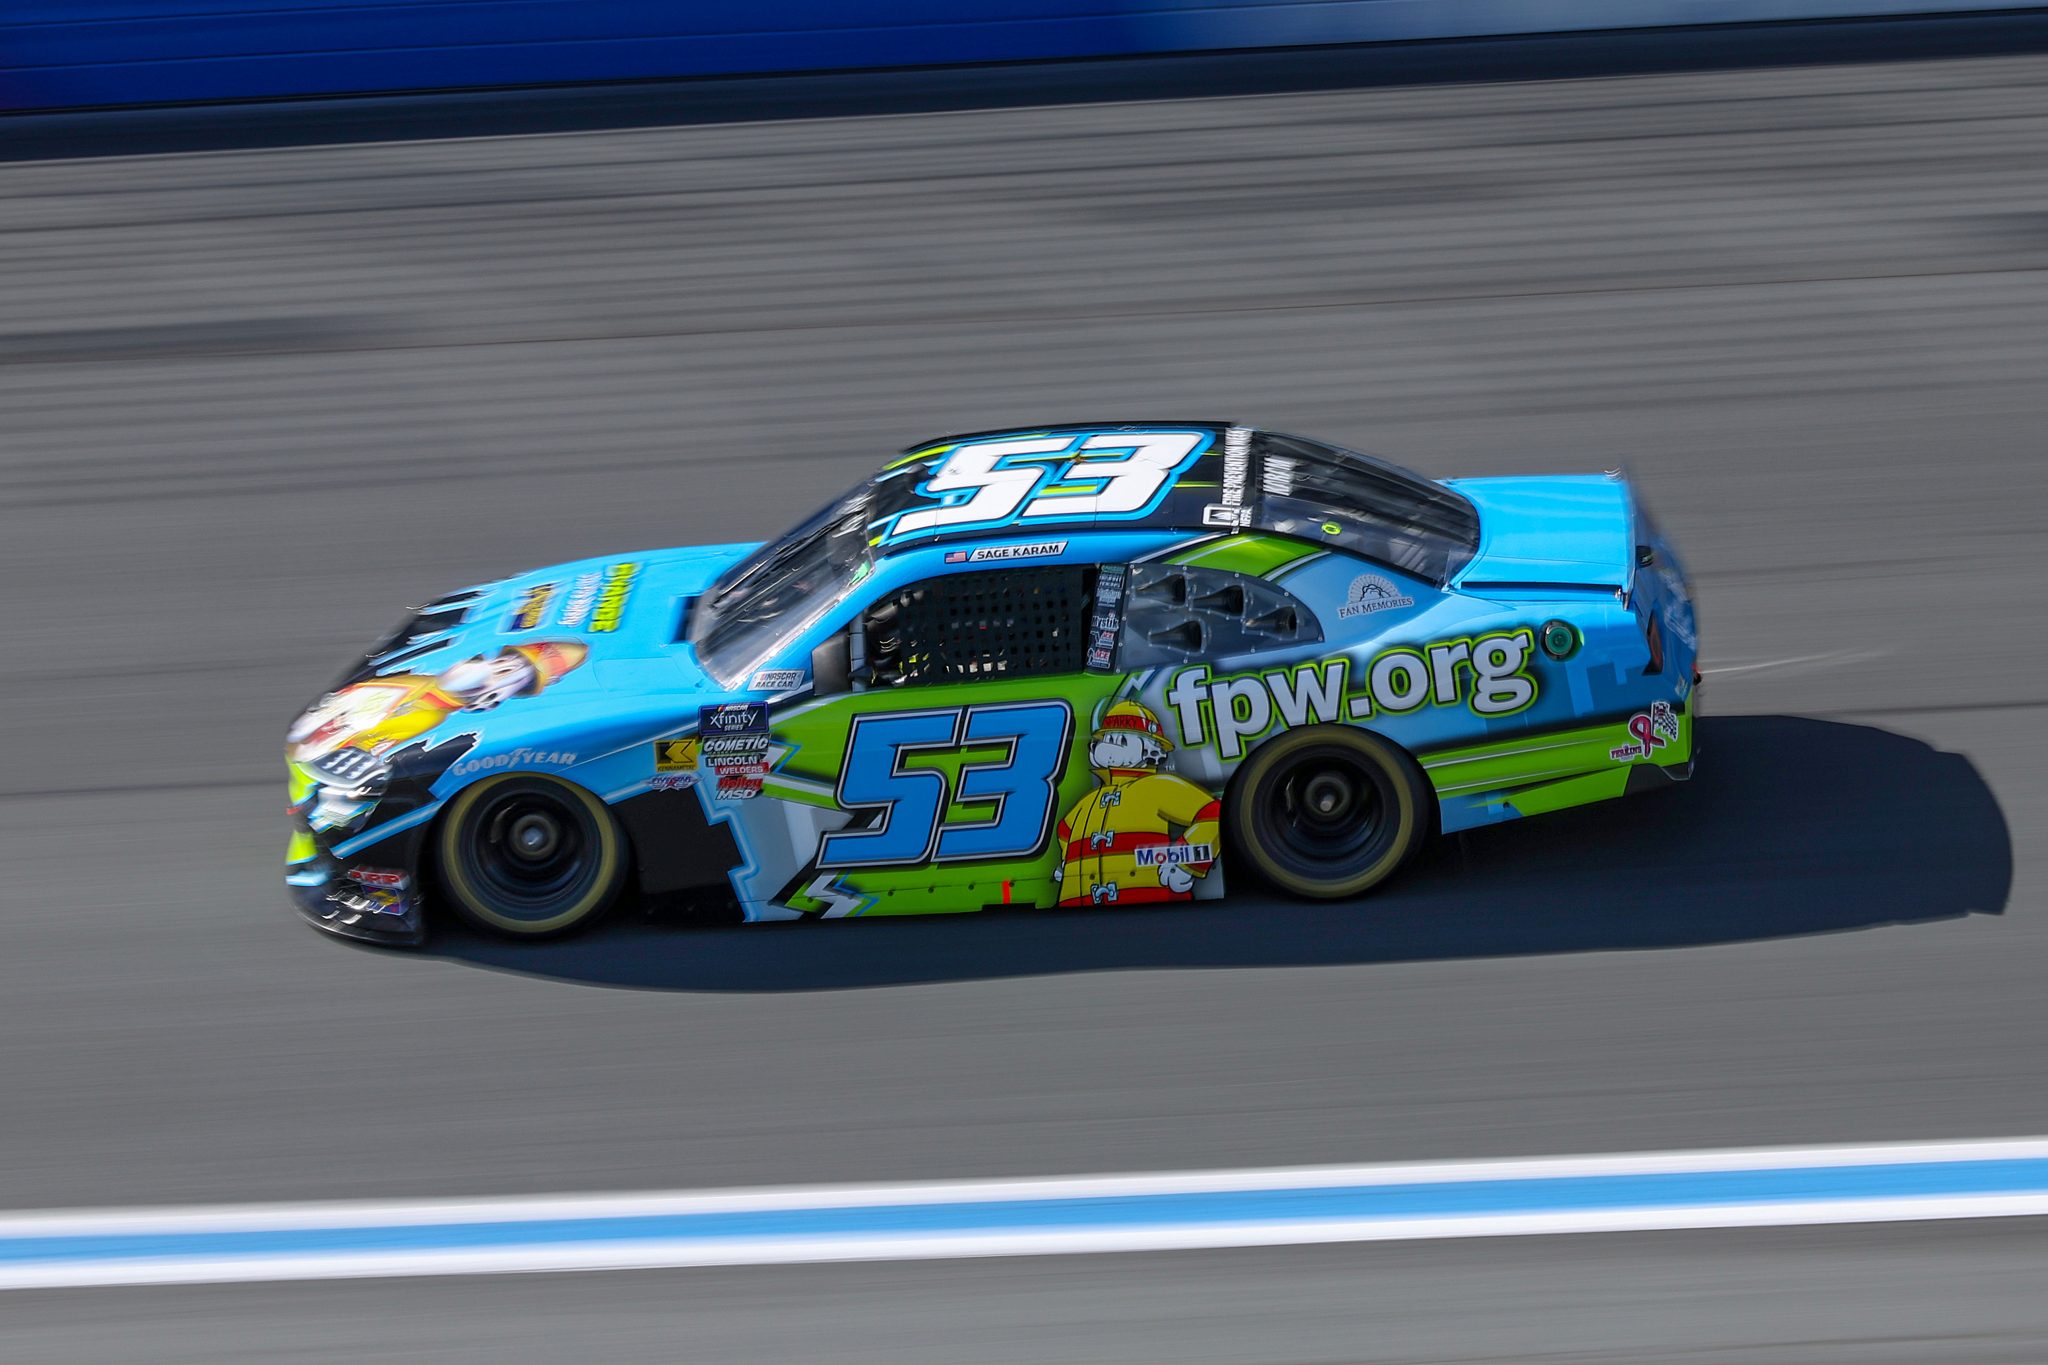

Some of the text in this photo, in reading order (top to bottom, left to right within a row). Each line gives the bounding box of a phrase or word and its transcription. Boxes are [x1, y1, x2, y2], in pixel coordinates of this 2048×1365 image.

[888, 431, 1204, 536] 53
[1221, 486, 1244, 506] FIRE
[977, 545, 1060, 560] SAGE KARAM
[1339, 598, 1413, 618] FAN MEMORIES
[766, 672, 797, 680] NASCAR
[1167, 633, 1536, 759] fpw.org
[710, 711, 759, 729] xfinity
[724, 724, 744, 732] SERIES
[703, 736, 769, 752] COMETIC
[452, 747, 578, 776] GOODYEAR
[708, 756, 757, 767] LINCOLN
[719, 766, 764, 775] WELDERS
[815, 698, 1076, 870] 53
[716, 789, 757, 800] MSD
[1136, 846, 1190, 866] Mobil
